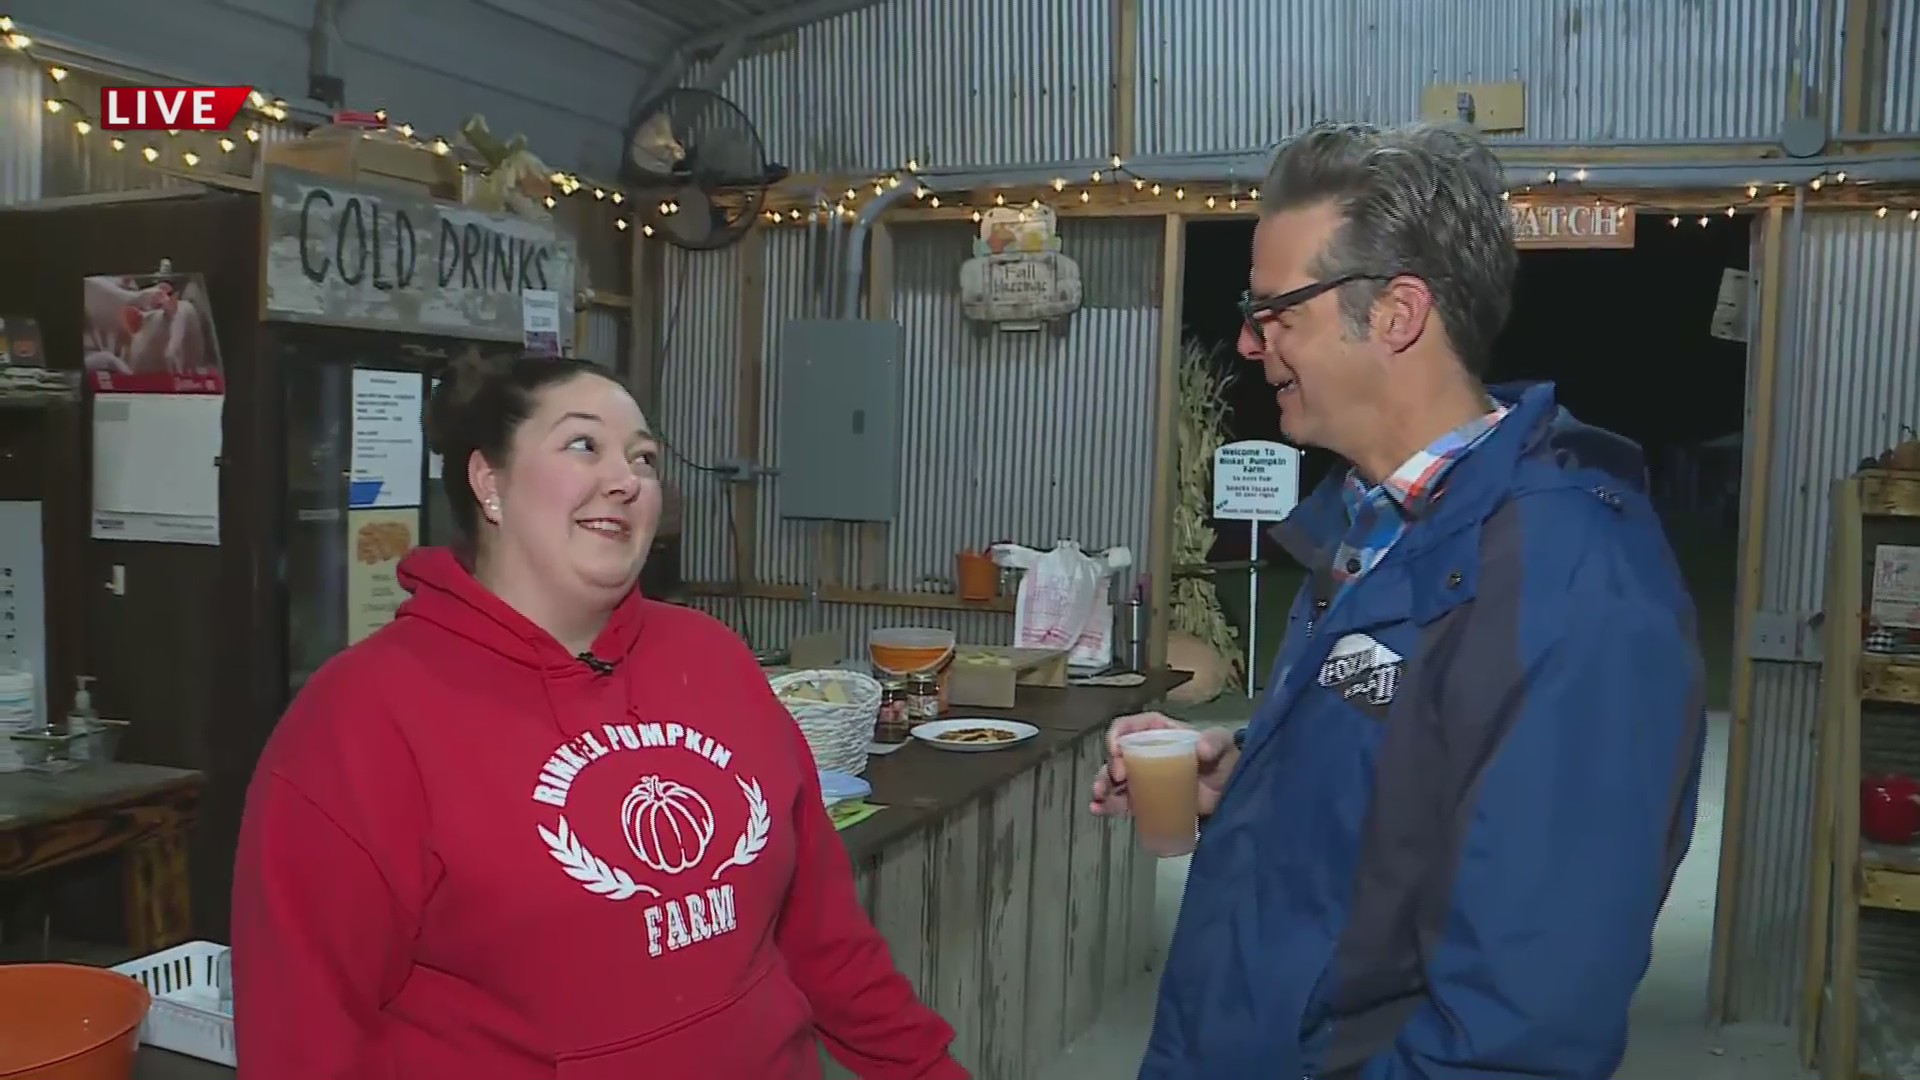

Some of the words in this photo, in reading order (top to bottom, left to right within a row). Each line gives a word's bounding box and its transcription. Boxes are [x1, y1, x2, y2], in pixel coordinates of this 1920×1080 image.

[300, 188, 417, 291] COLD
[438, 217, 549, 295] DRINKS
[1221, 448, 1260, 456] Welcome
[1264, 448, 1276, 456] To
[1249, 457, 1287, 467] Pumpkin
[532, 731, 610, 807] RINKEL
[603, 722, 733, 770] PUMPKIN
[644, 884, 737, 957] FARM
